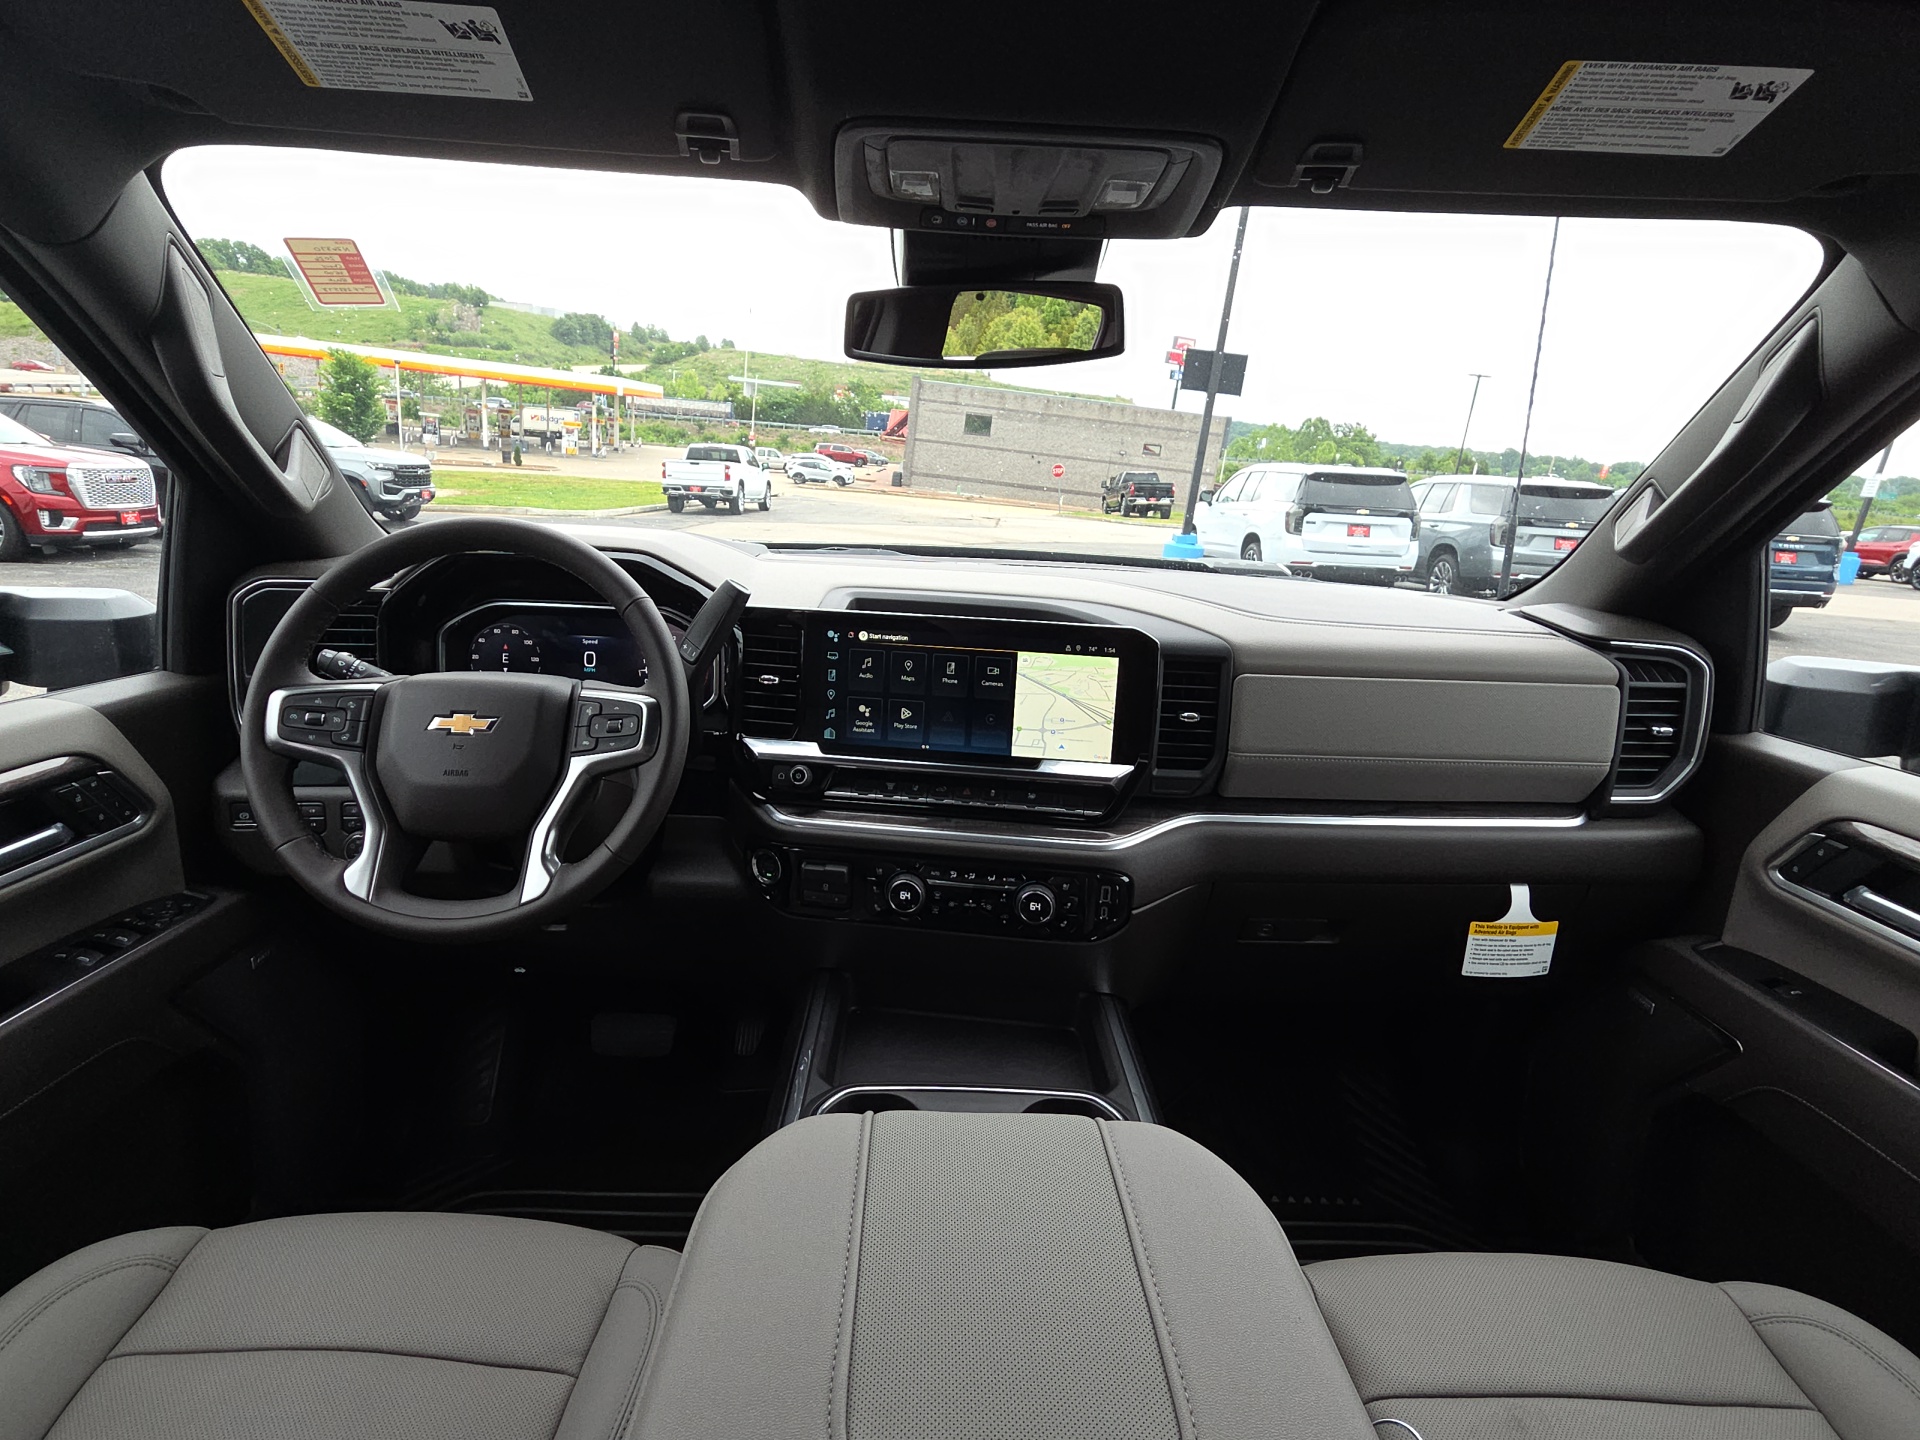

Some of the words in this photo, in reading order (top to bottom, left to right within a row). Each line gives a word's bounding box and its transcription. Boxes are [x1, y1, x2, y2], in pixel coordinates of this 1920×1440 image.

[320, 41, 341, 50] AVEC
[341, 43, 359, 51] DES
[358, 44, 381, 53] SACS
[380, 46, 432, 57] GONFLABLES
[431, 50, 486, 60] INTELLIGENTS
[1629, 63, 1678, 71] ADVANCED
[1631, 108, 1682, 116] GONFLABLES
[1680, 110, 1735, 118] INTELLIGENTS
[502, 652, 510, 664] E
[584, 651, 596, 667] 0
[900, 891, 910, 900] 64
[1030, 902, 1041, 911] 64
